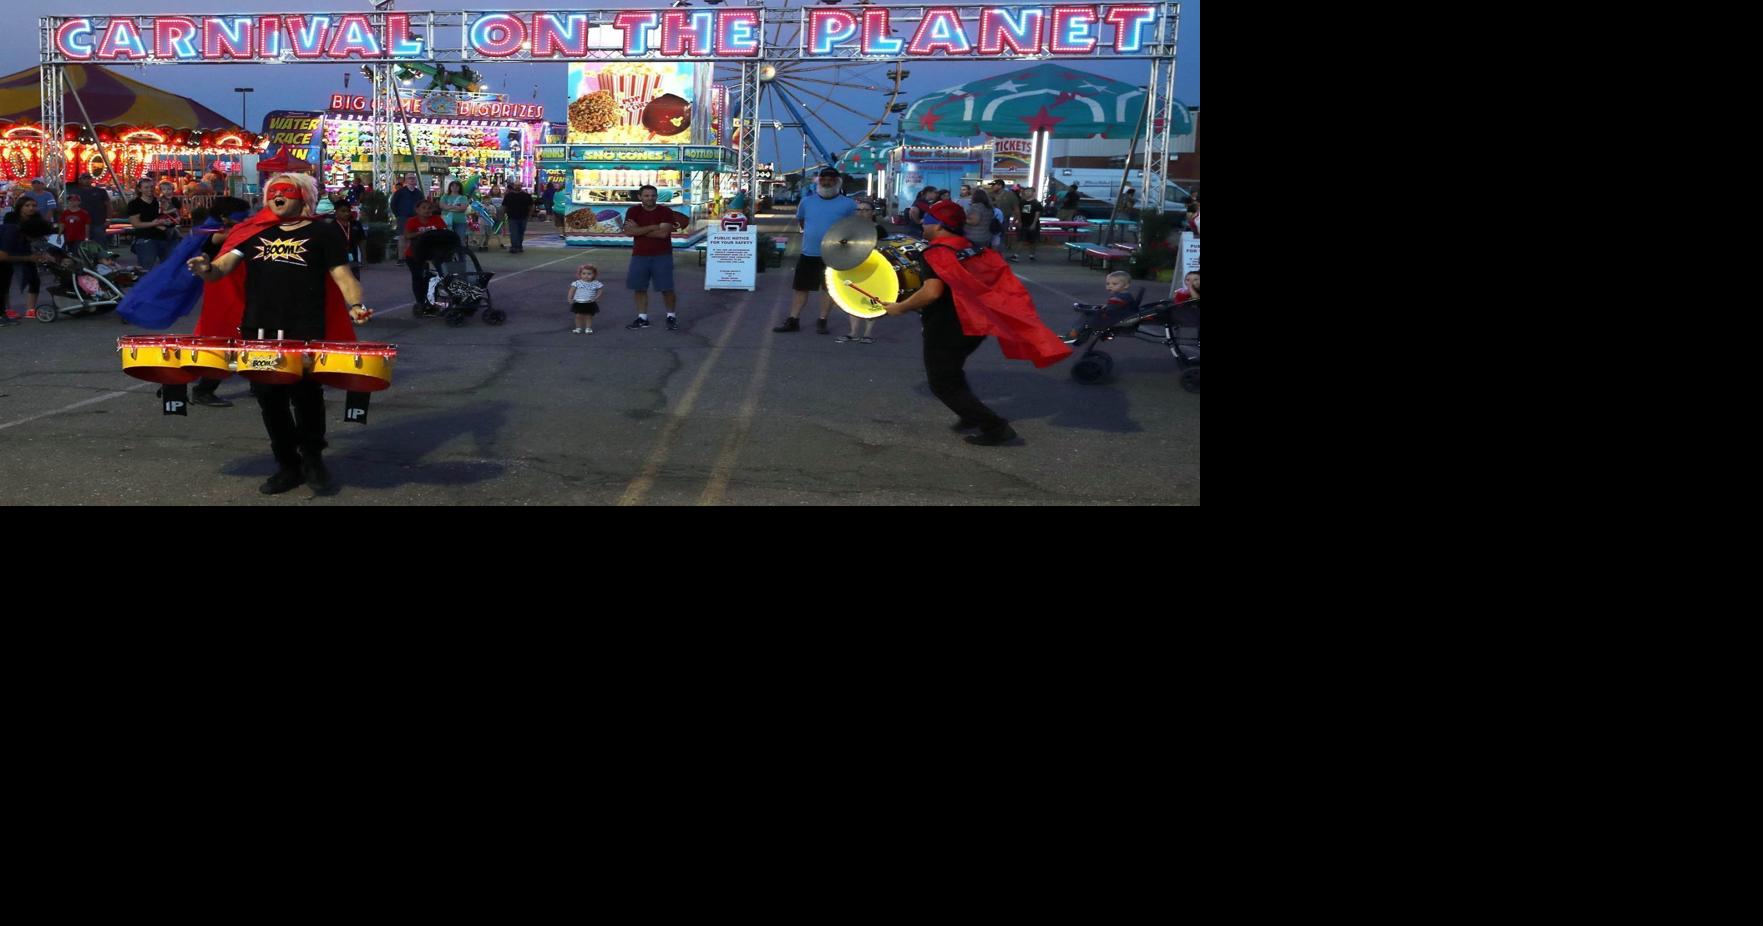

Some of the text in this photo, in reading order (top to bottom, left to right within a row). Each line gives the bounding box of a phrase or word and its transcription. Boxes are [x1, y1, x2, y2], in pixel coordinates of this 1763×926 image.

[55, 4, 1157, 60] CARNIVAL ON THE PLANET
[332, 95, 366, 110] BIG
[270, 117, 320, 130] WATER
[273, 132, 312, 144] RACE
[994, 140, 1032, 152] TICKETS
[583, 150, 616, 160] SNO
[618, 150, 663, 160] CONES
[165, 400, 184, 412] IP
[347, 407, 365, 419] IP
